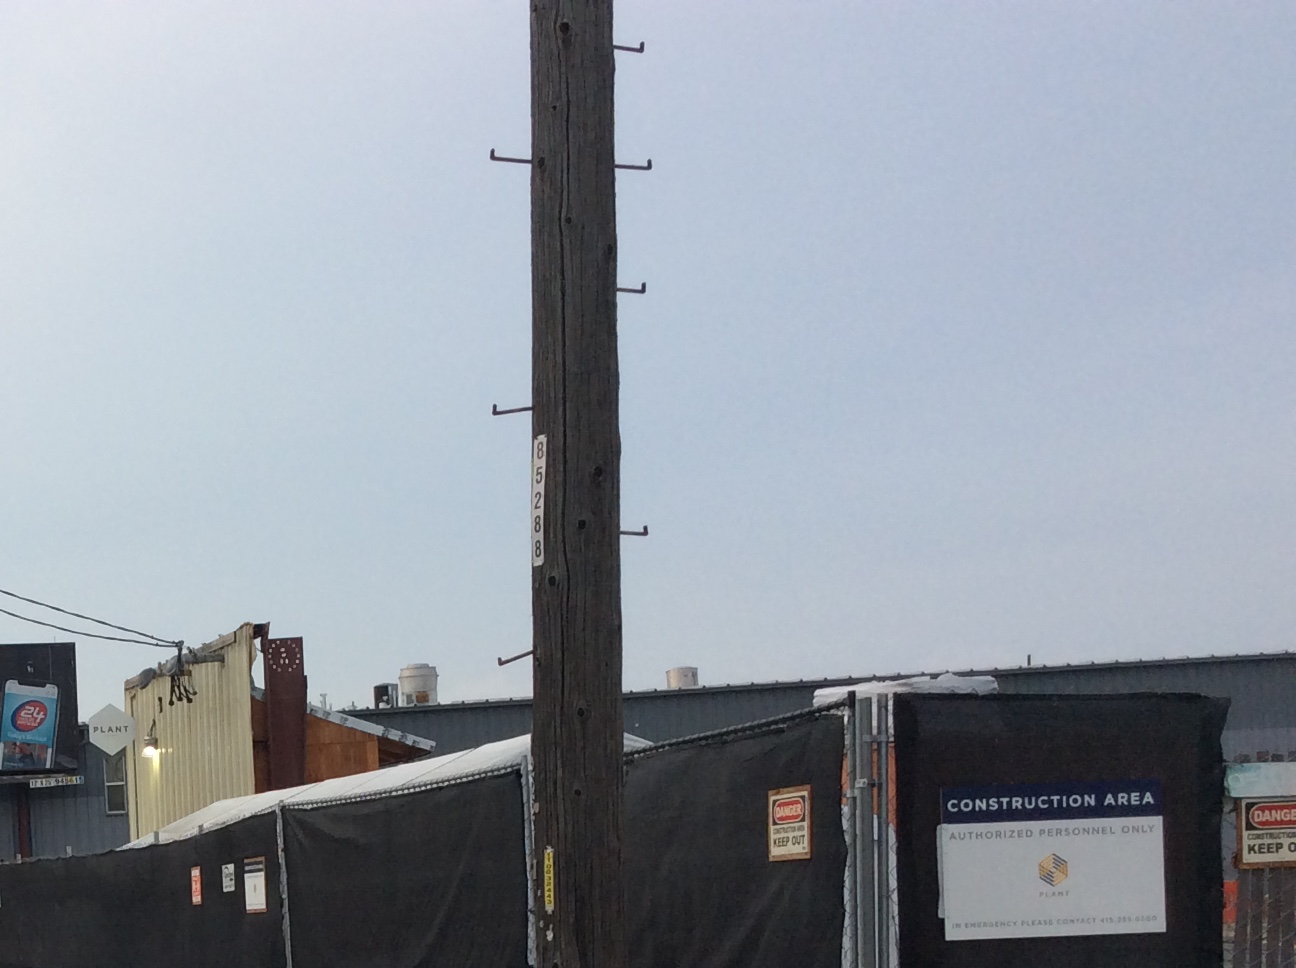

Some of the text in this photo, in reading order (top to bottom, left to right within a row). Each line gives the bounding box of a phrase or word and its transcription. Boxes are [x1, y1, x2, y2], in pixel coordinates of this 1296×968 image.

[534, 441, 544, 558] 85288
[20, 705, 45, 723] 24
[93, 725, 129, 734] PLANT
[947, 791, 1155, 812] CONSTRUCTION AREA
[775, 803, 802, 818] DANGER
[1254, 809, 1296, 822] DANGE
[949, 824, 1156, 841] AUTHORIZED PERSONNEL ONLY
[773, 834, 806, 848] KEEP OUT
[1247, 842, 1284, 854] KEEP
[1039, 890, 1070, 898] PLANT
[965, 920, 1017, 929] EMERGENCY
[1021, 919, 1054, 927] PLEASE
[1057, 917, 1096, 925] CONTACT
